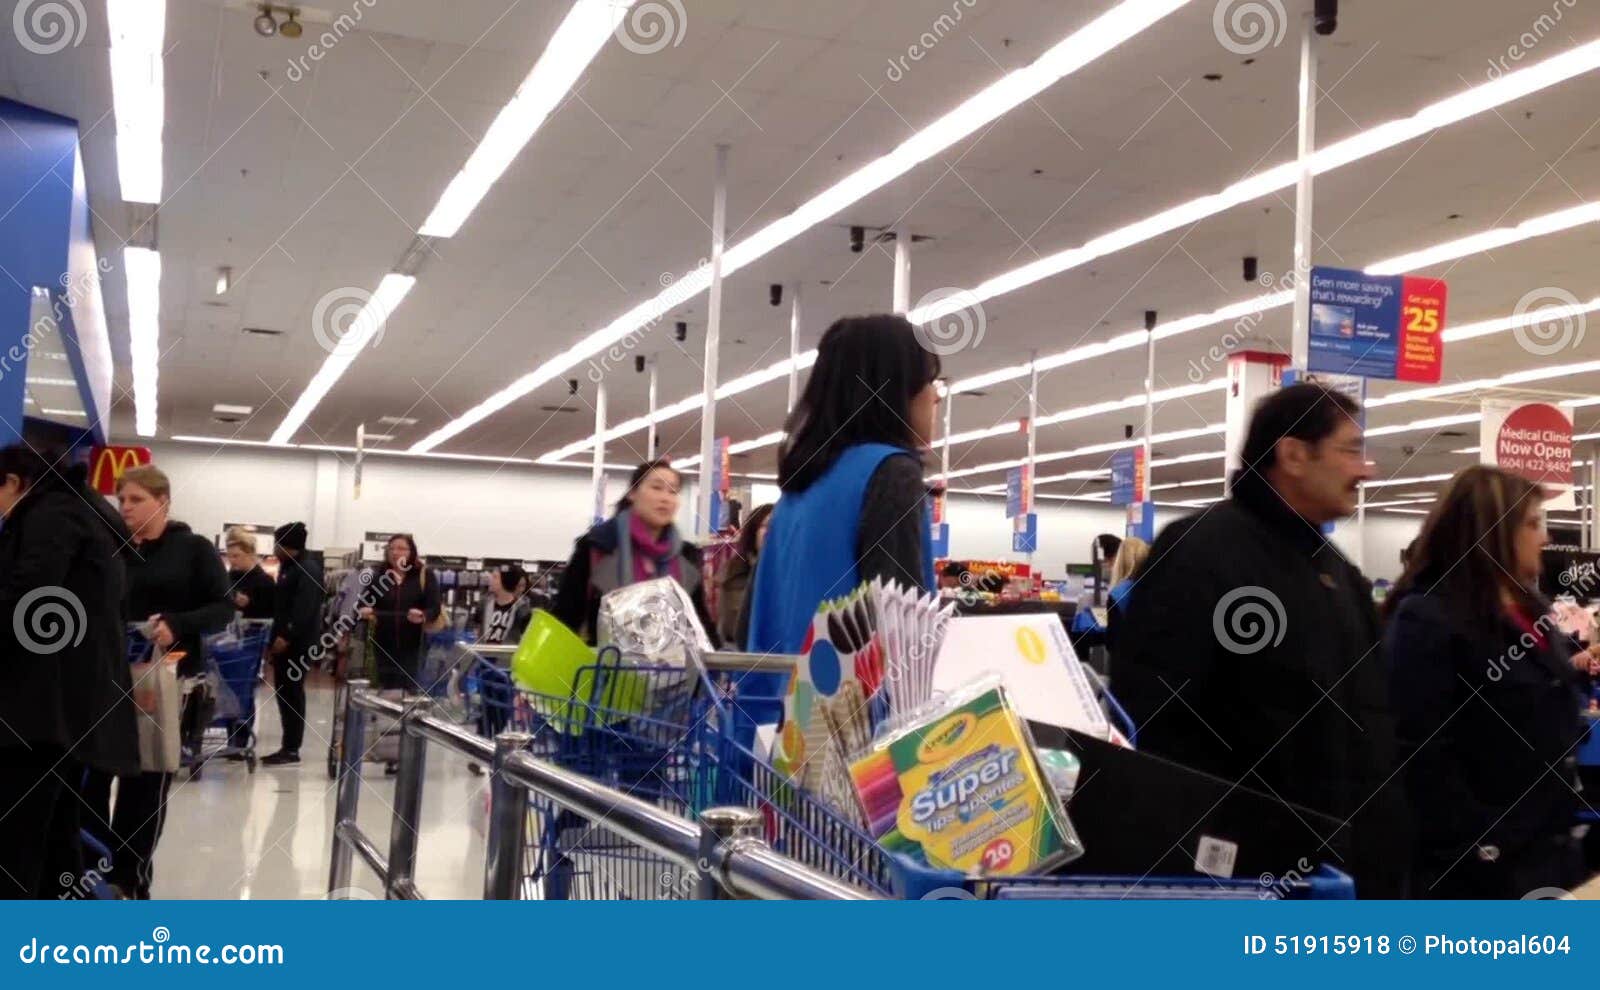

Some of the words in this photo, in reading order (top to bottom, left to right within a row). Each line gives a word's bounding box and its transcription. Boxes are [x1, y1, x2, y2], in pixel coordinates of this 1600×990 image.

[1313, 275, 1335, 288] Even
[1336, 280, 1360, 292] more
[1312, 289, 1335, 301] that's
[1404, 306, 1439, 333] $25
[1500, 428, 1541, 440] Medical
[1542, 430, 1571, 444] Clinic
[1500, 440, 1533, 456] Now
[1534, 442, 1572, 460] Open
[911, 749, 1019, 823] Super
[985, 840, 1012, 866] 20
